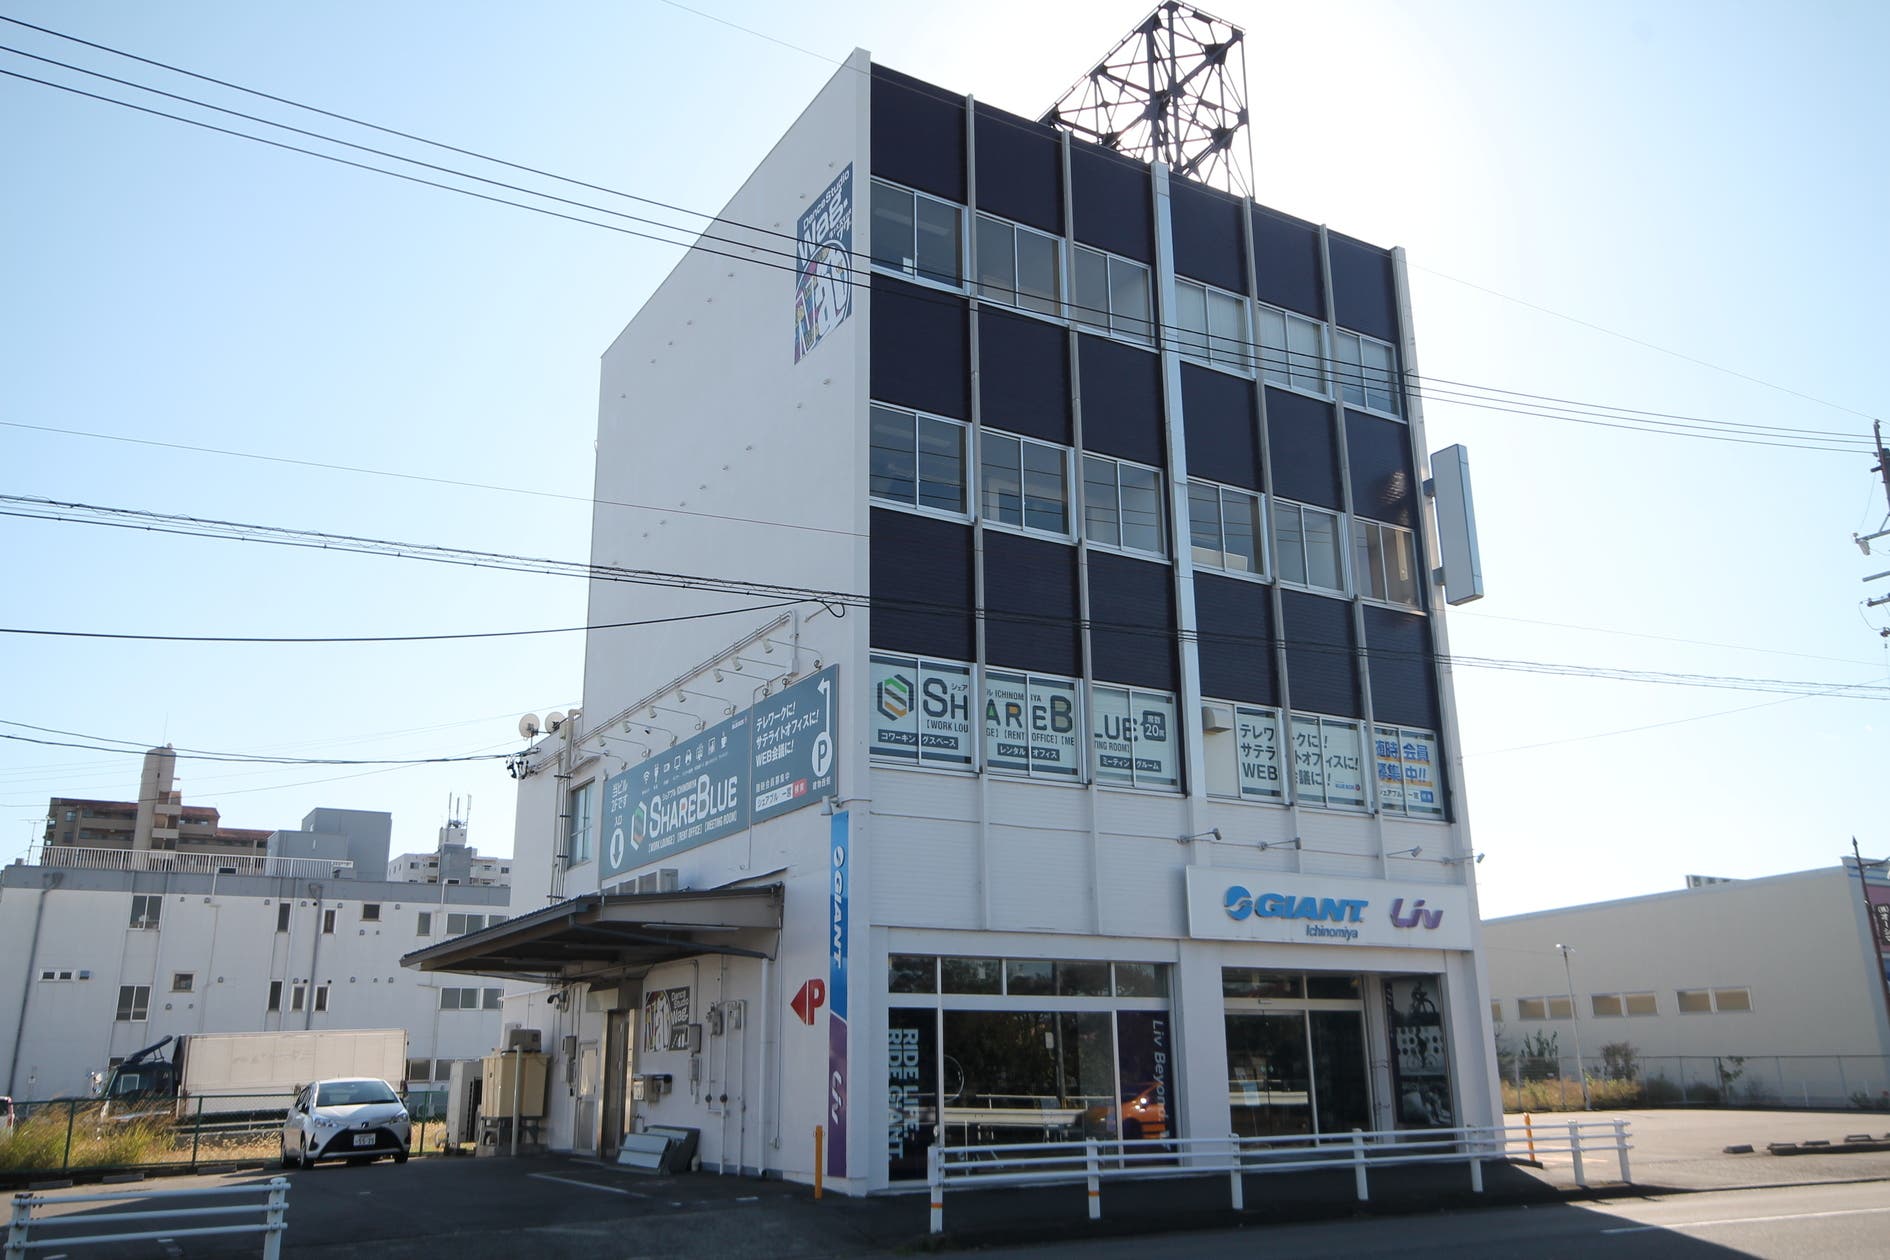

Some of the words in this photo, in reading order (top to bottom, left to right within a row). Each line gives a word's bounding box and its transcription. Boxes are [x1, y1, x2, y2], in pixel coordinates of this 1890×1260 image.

[834, 871, 844, 969] GIANT
[1254, 893, 1369, 923] GIANT
[1391, 898, 1444, 930] Liv
[1306, 925, 1358, 941] Ichinomiya
[889, 1028, 903, 1080] RIDE
[903, 1028, 919, 1080] RIDE
[1152, 1019, 1165, 1047] Liv
